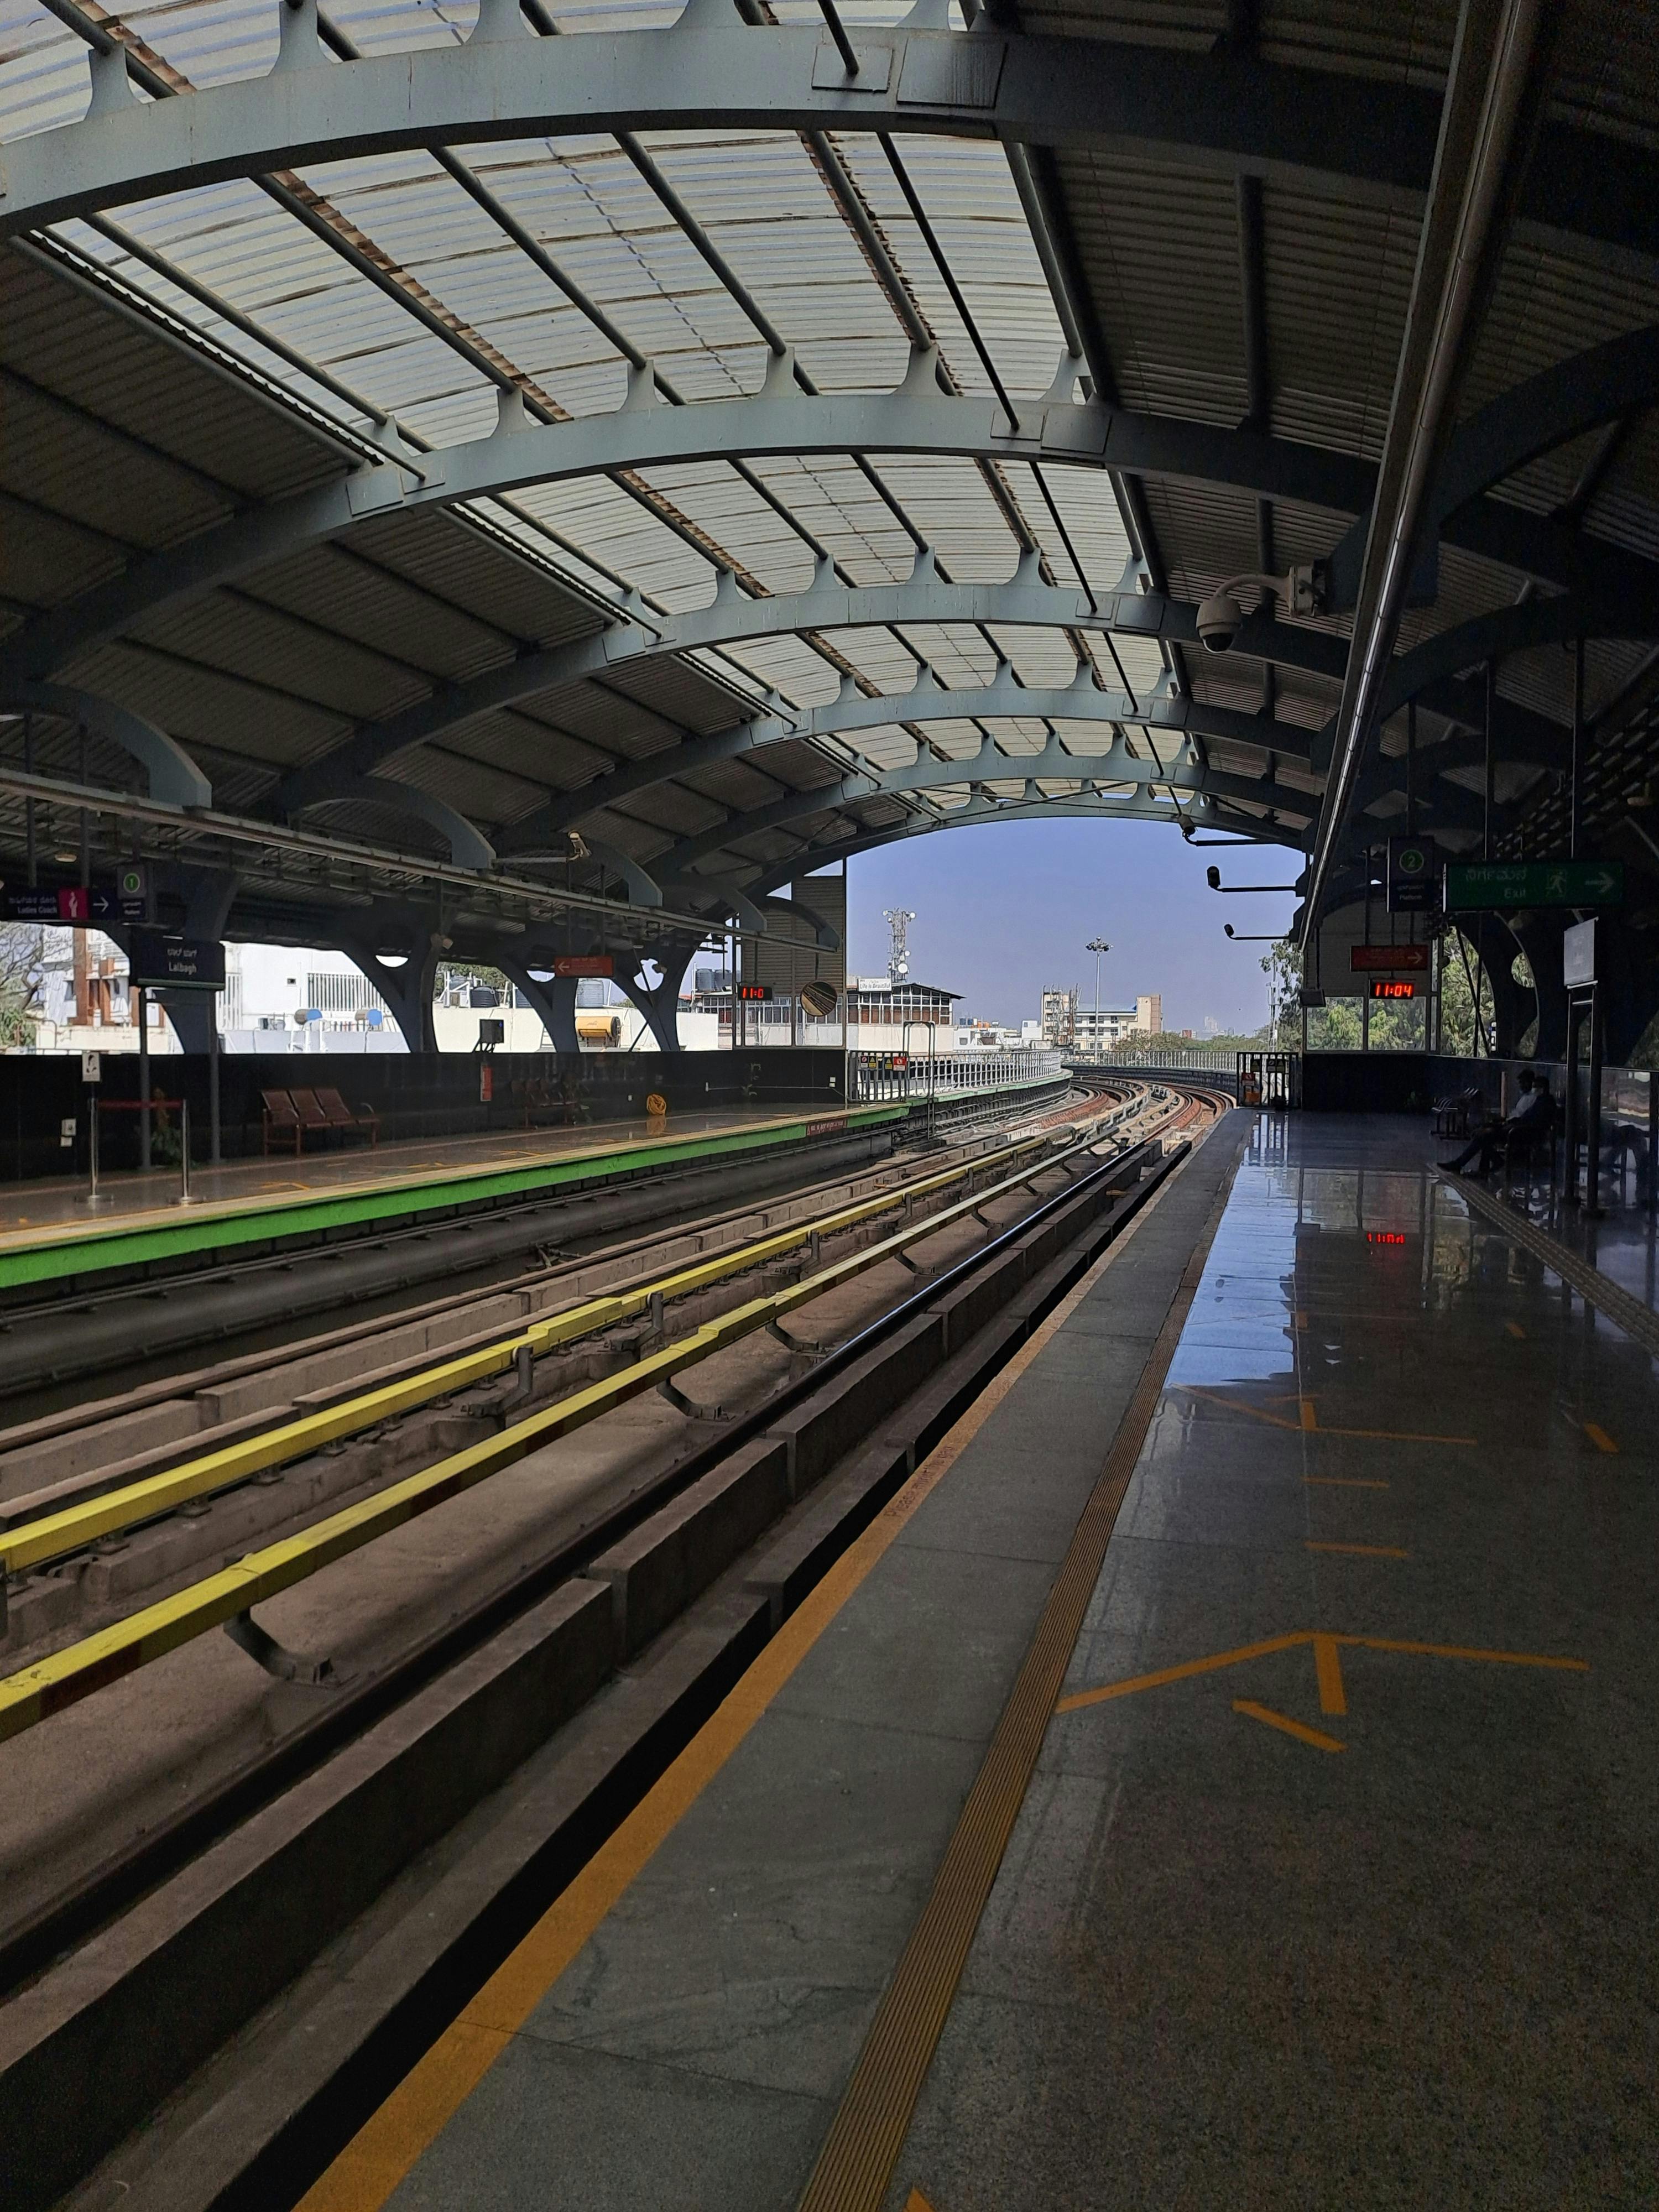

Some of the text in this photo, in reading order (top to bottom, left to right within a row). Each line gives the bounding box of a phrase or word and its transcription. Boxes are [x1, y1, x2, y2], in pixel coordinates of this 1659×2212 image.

[1408, 855, 1416, 867] 2
[1504, 888, 1526, 899] Exit
[17, 906, 58, 914] Ladies Coach
[169, 962, 197, 975] Lalbagh
[1375, 983, 1413, 997] 11:04
